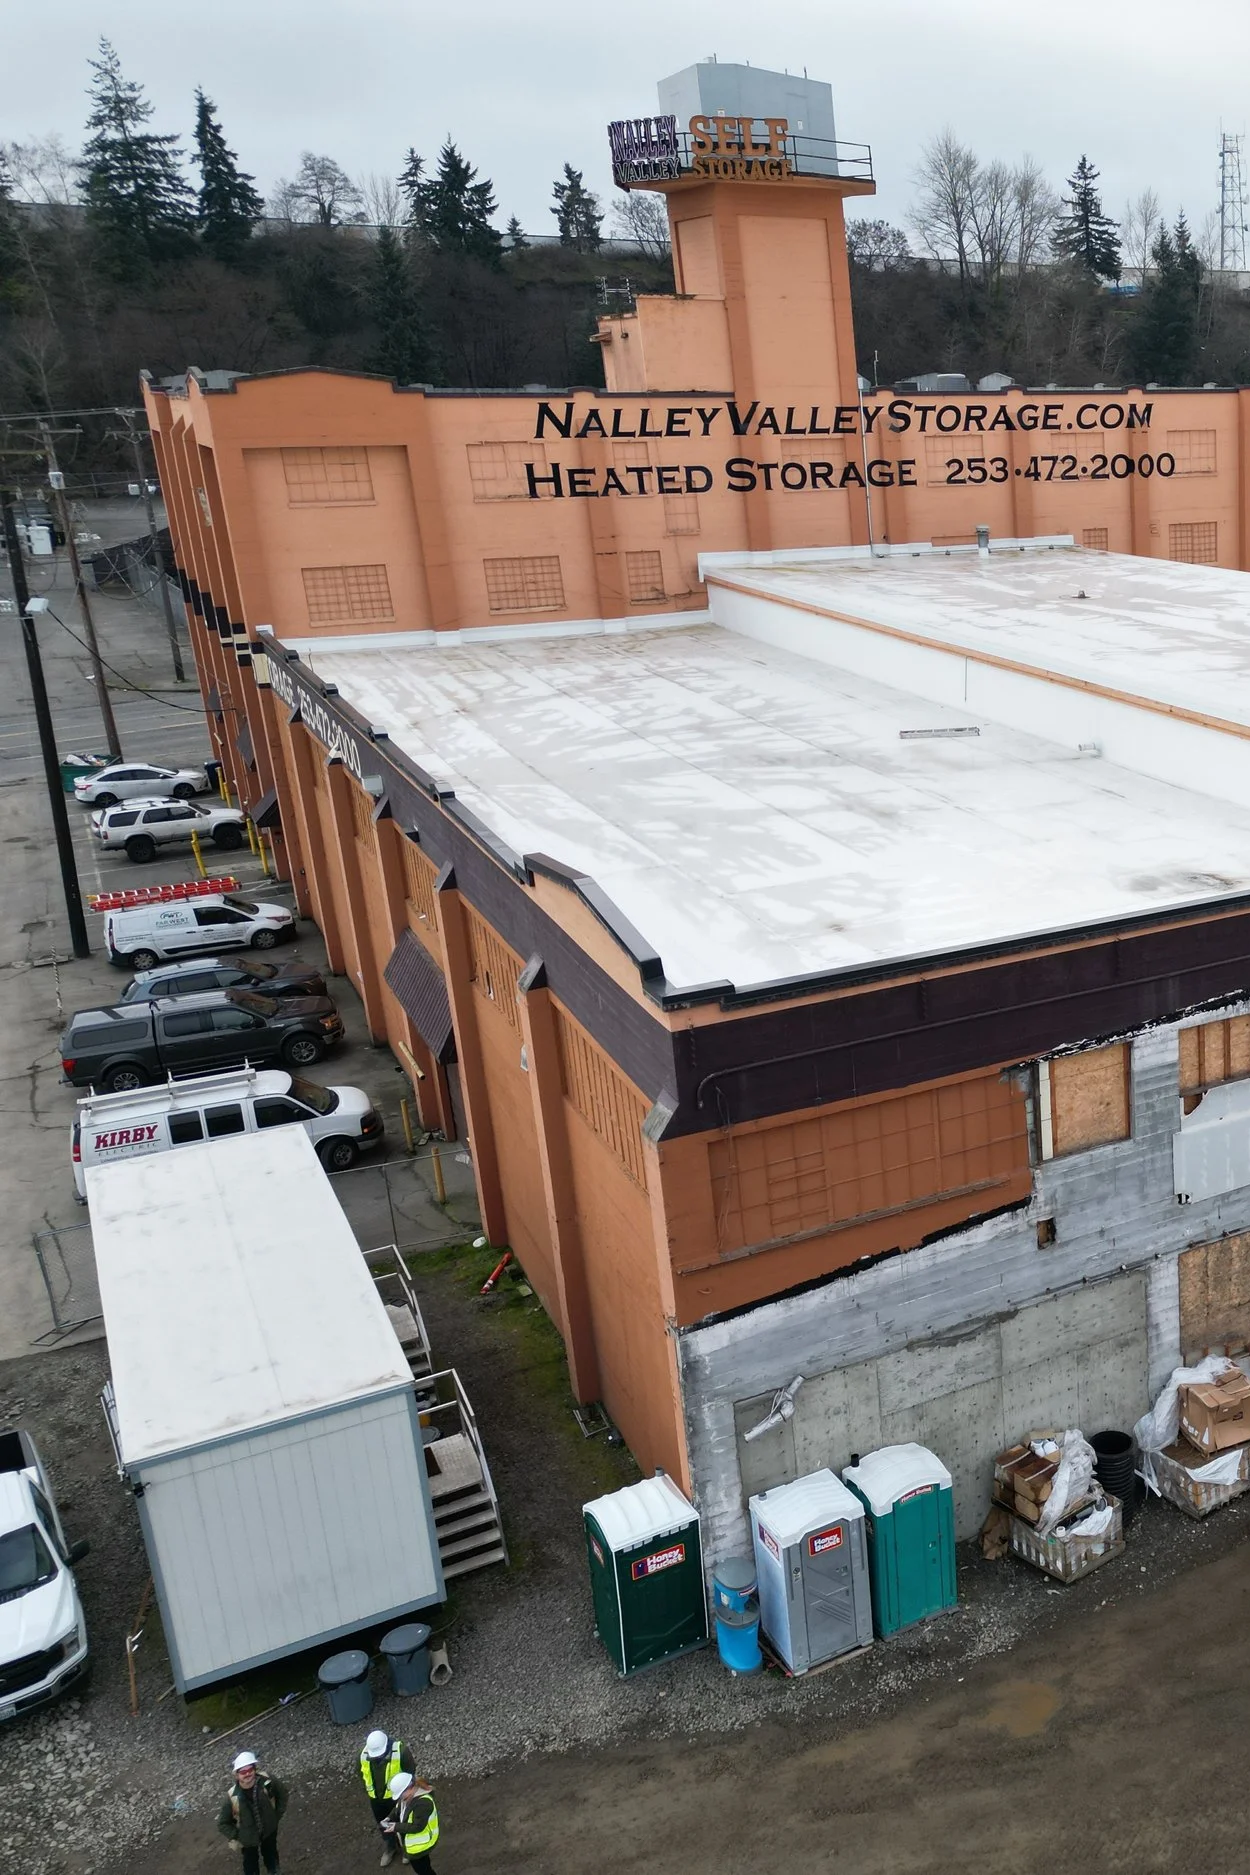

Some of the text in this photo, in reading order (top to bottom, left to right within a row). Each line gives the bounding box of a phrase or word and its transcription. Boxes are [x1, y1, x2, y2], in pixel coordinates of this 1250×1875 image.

[609, 115, 679, 163] NALLEY
[688, 115, 789, 158] SELF
[613, 157, 681, 183] VALLEY
[691, 156, 794, 181] STORAGE
[524, 462, 714, 499] HEATED
[724, 457, 918, 493] STORAGE
[94, 1124, 159, 1149] KIRBY
[647, 1548, 680, 1566] Honey
[648, 1553, 684, 1573] Bucket
